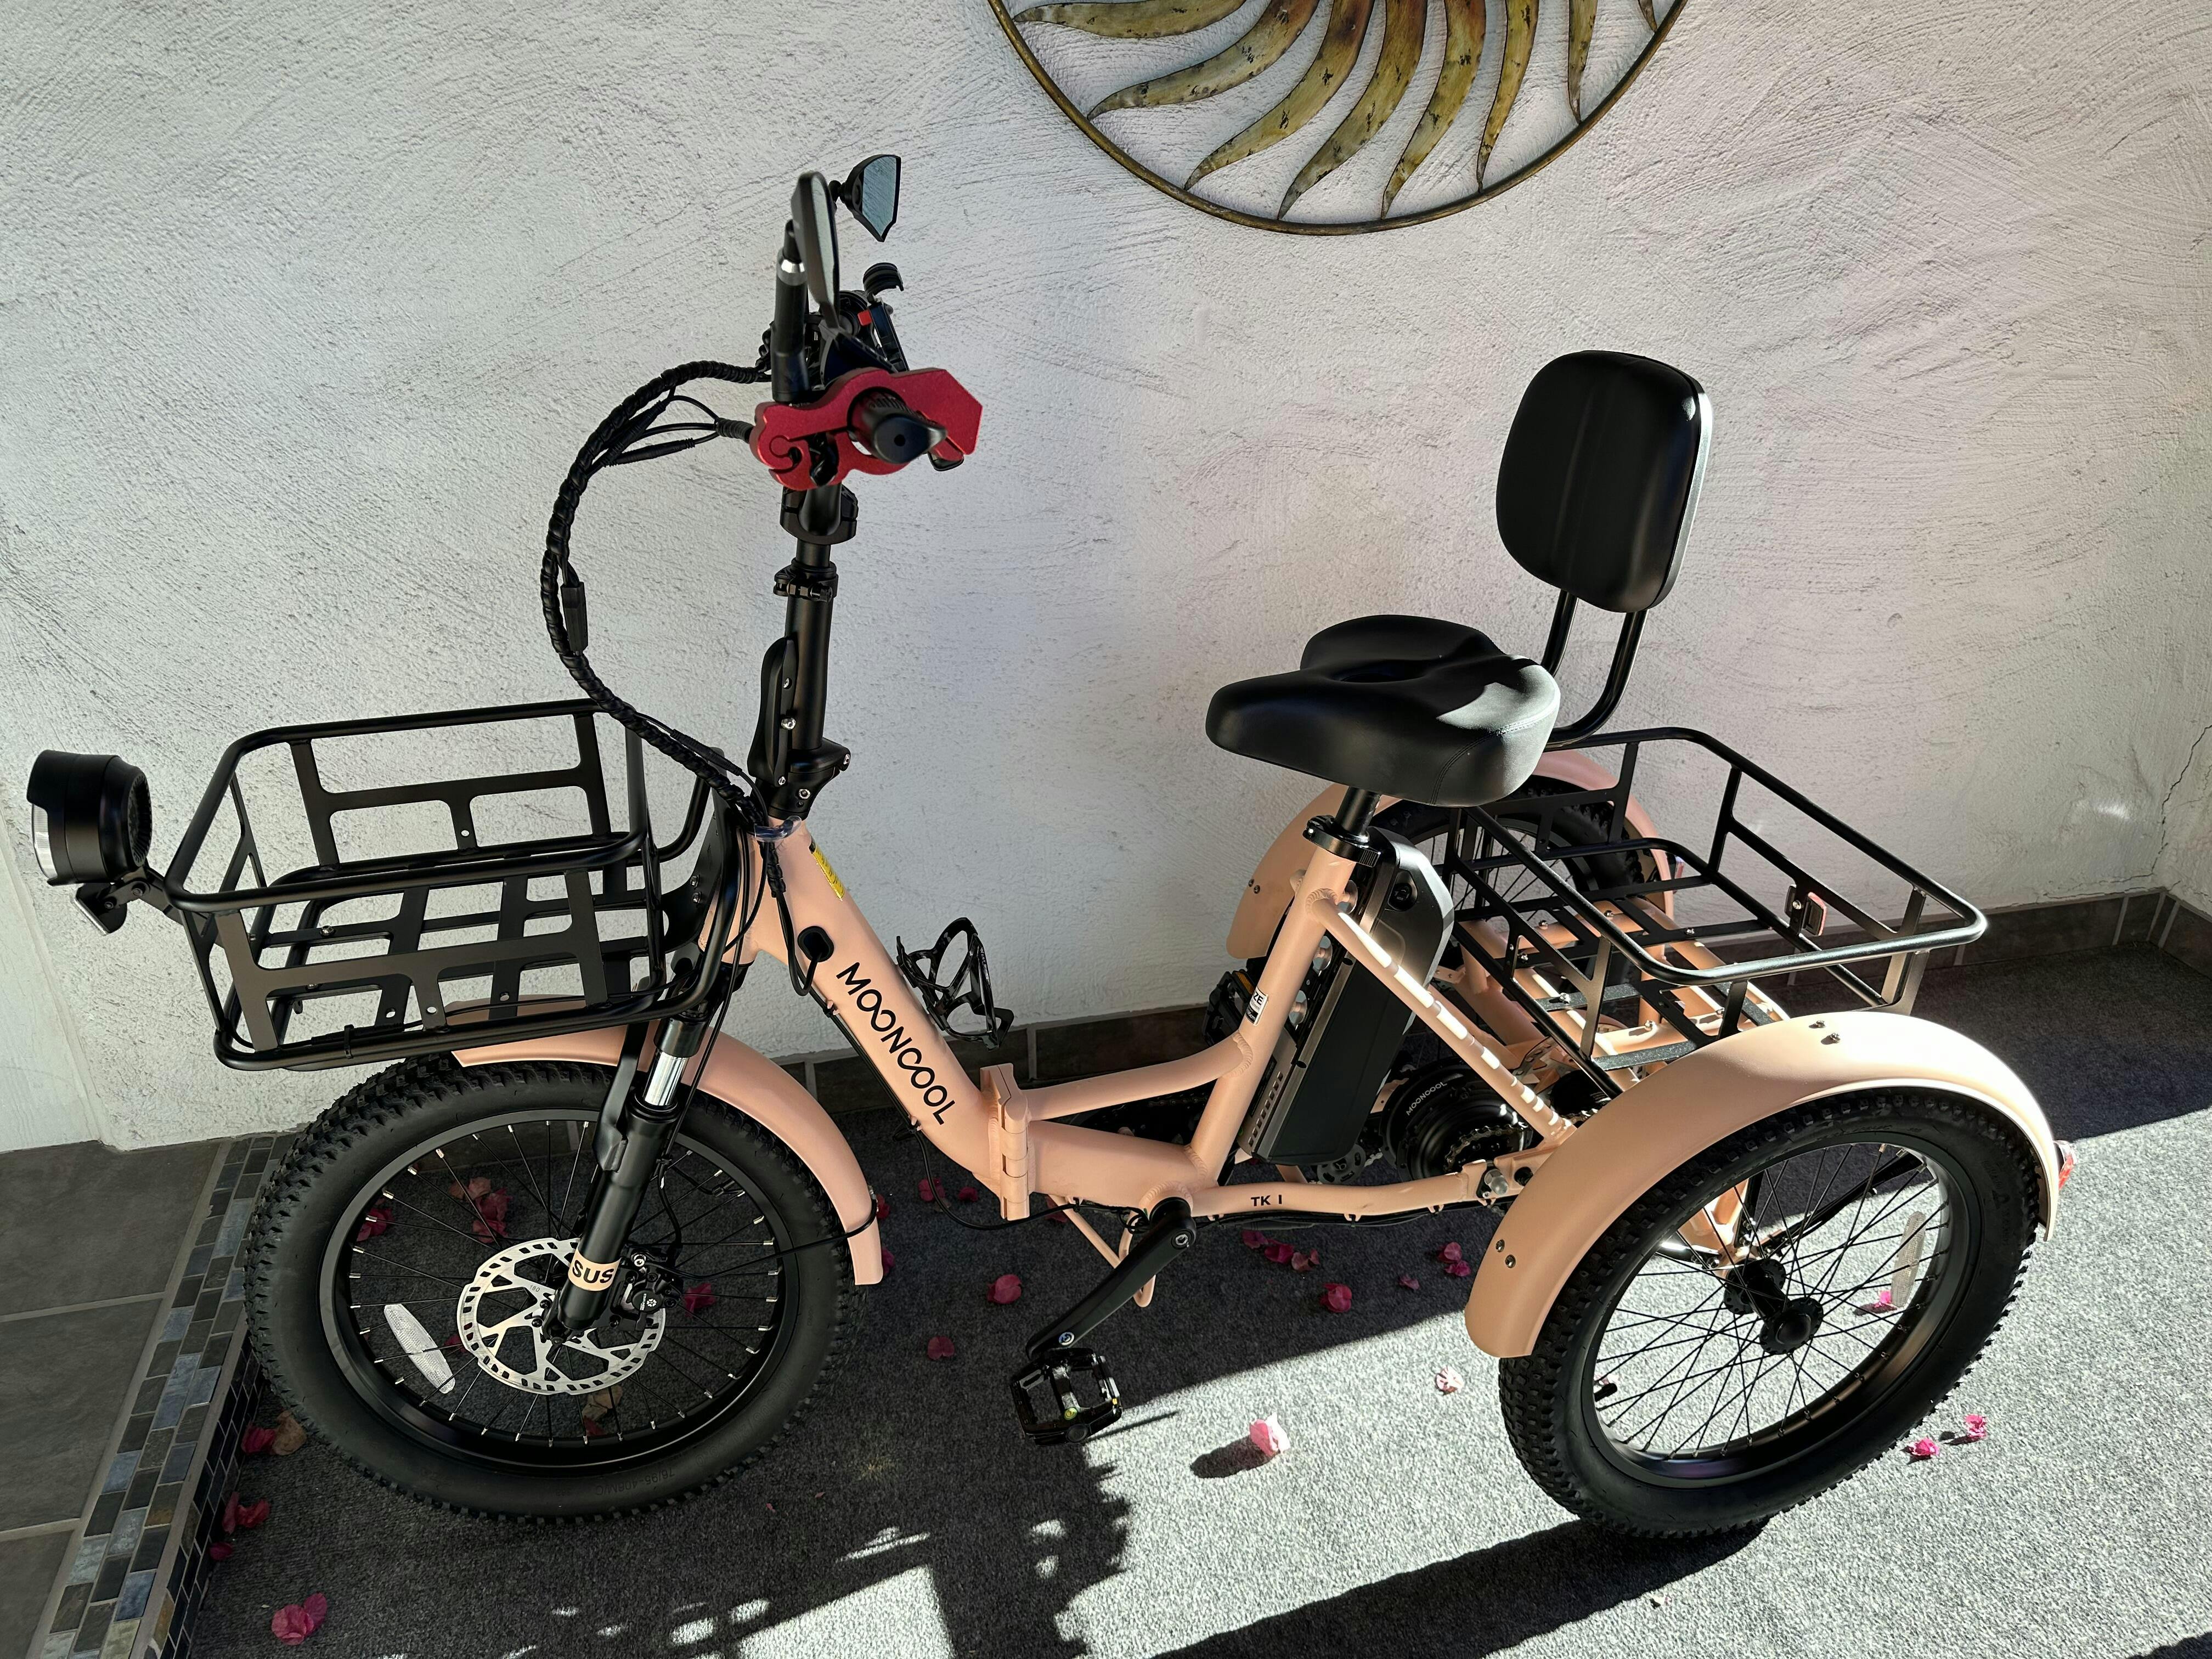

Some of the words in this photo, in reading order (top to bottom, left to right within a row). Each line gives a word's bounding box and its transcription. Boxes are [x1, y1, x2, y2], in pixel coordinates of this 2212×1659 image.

[1253, 991, 1263, 1006] ZE
[836, 962, 956, 1125] MOONCOOL
[1406, 1082, 1448, 1116] MOONCOOL
[1251, 1195, 1271, 1206] TK
[572, 1260, 614, 1284] SUS
